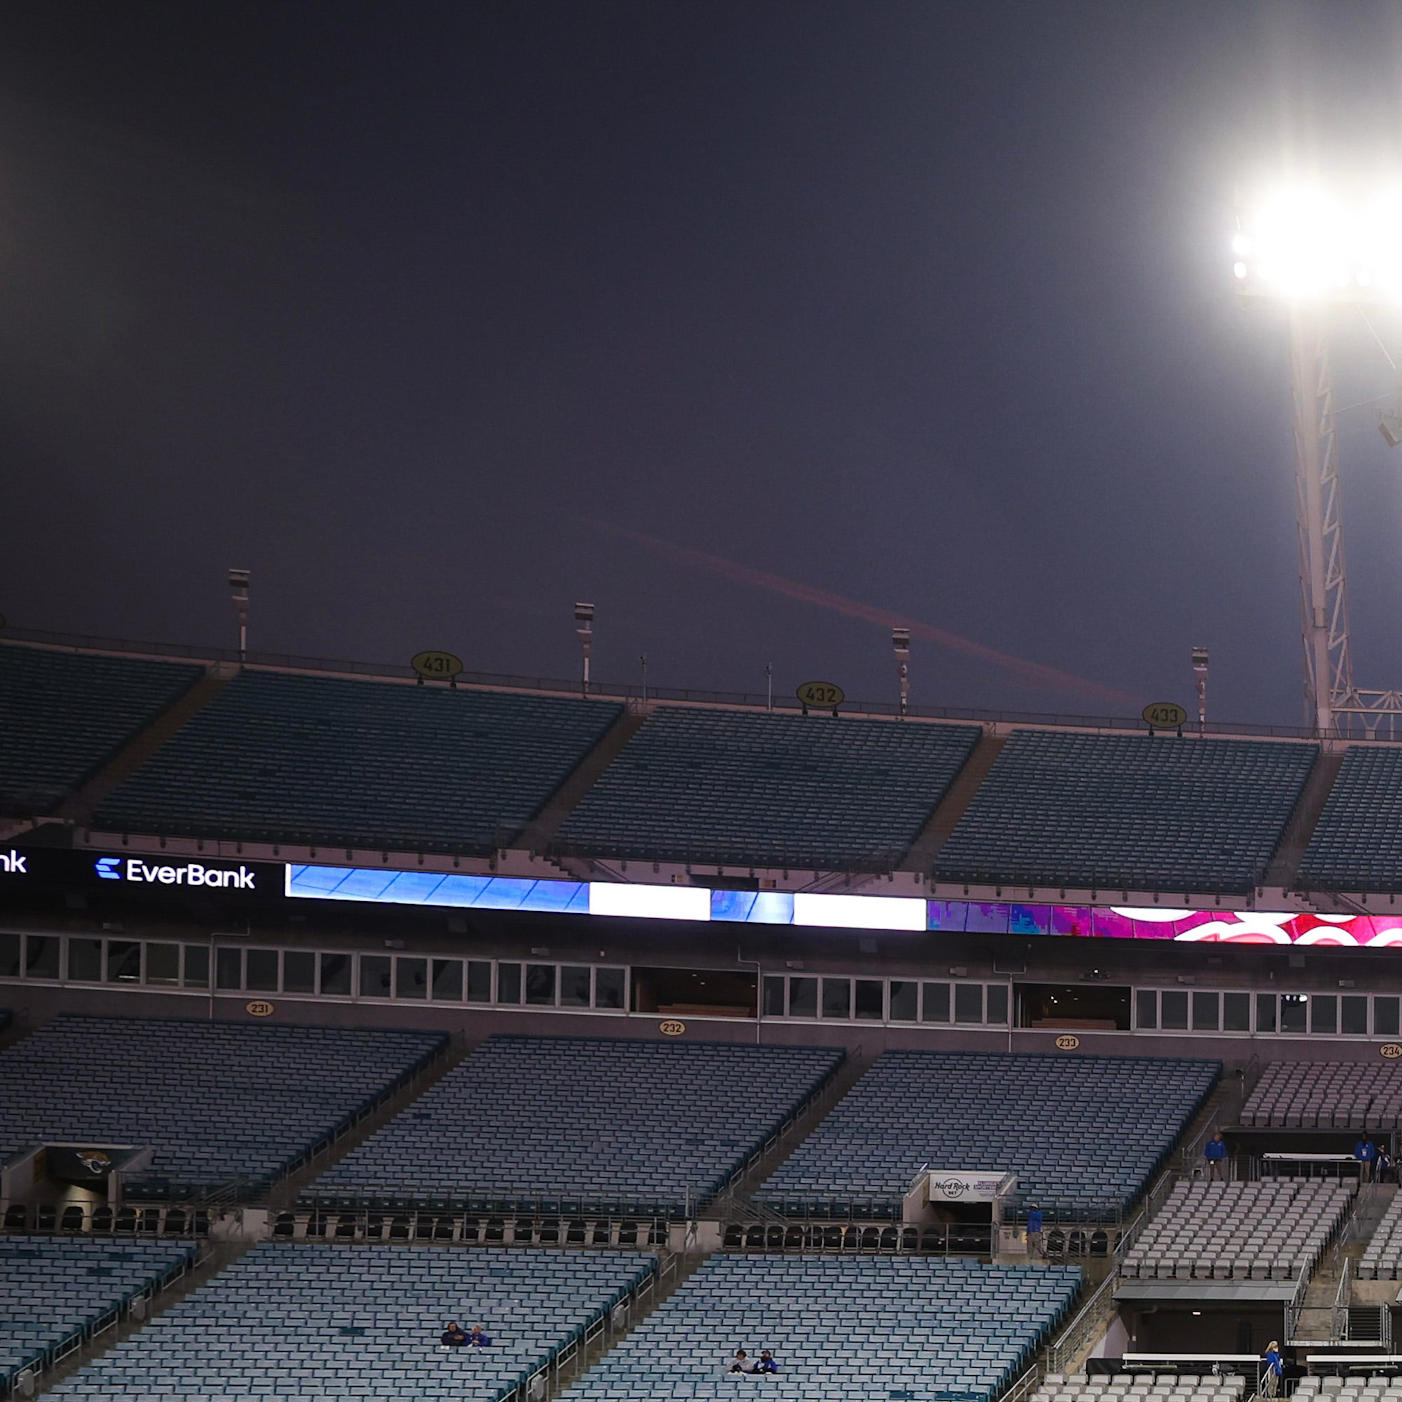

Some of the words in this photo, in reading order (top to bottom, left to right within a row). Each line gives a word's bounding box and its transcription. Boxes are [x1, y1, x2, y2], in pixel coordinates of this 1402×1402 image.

[424, 657, 451, 673] 431
[806, 687, 836, 703] 432
[1151, 708, 1178, 722] 433
[127, 859, 255, 889] EverBank
[252, 1004, 268, 1013] 231
[663, 1022, 681, 1032] 232
[1060, 1038, 1076, 1047] 233
[1383, 1046, 1400, 1055] 234
[935, 1181, 952, 1190] Hard
[953, 1182, 970, 1191] Rock
